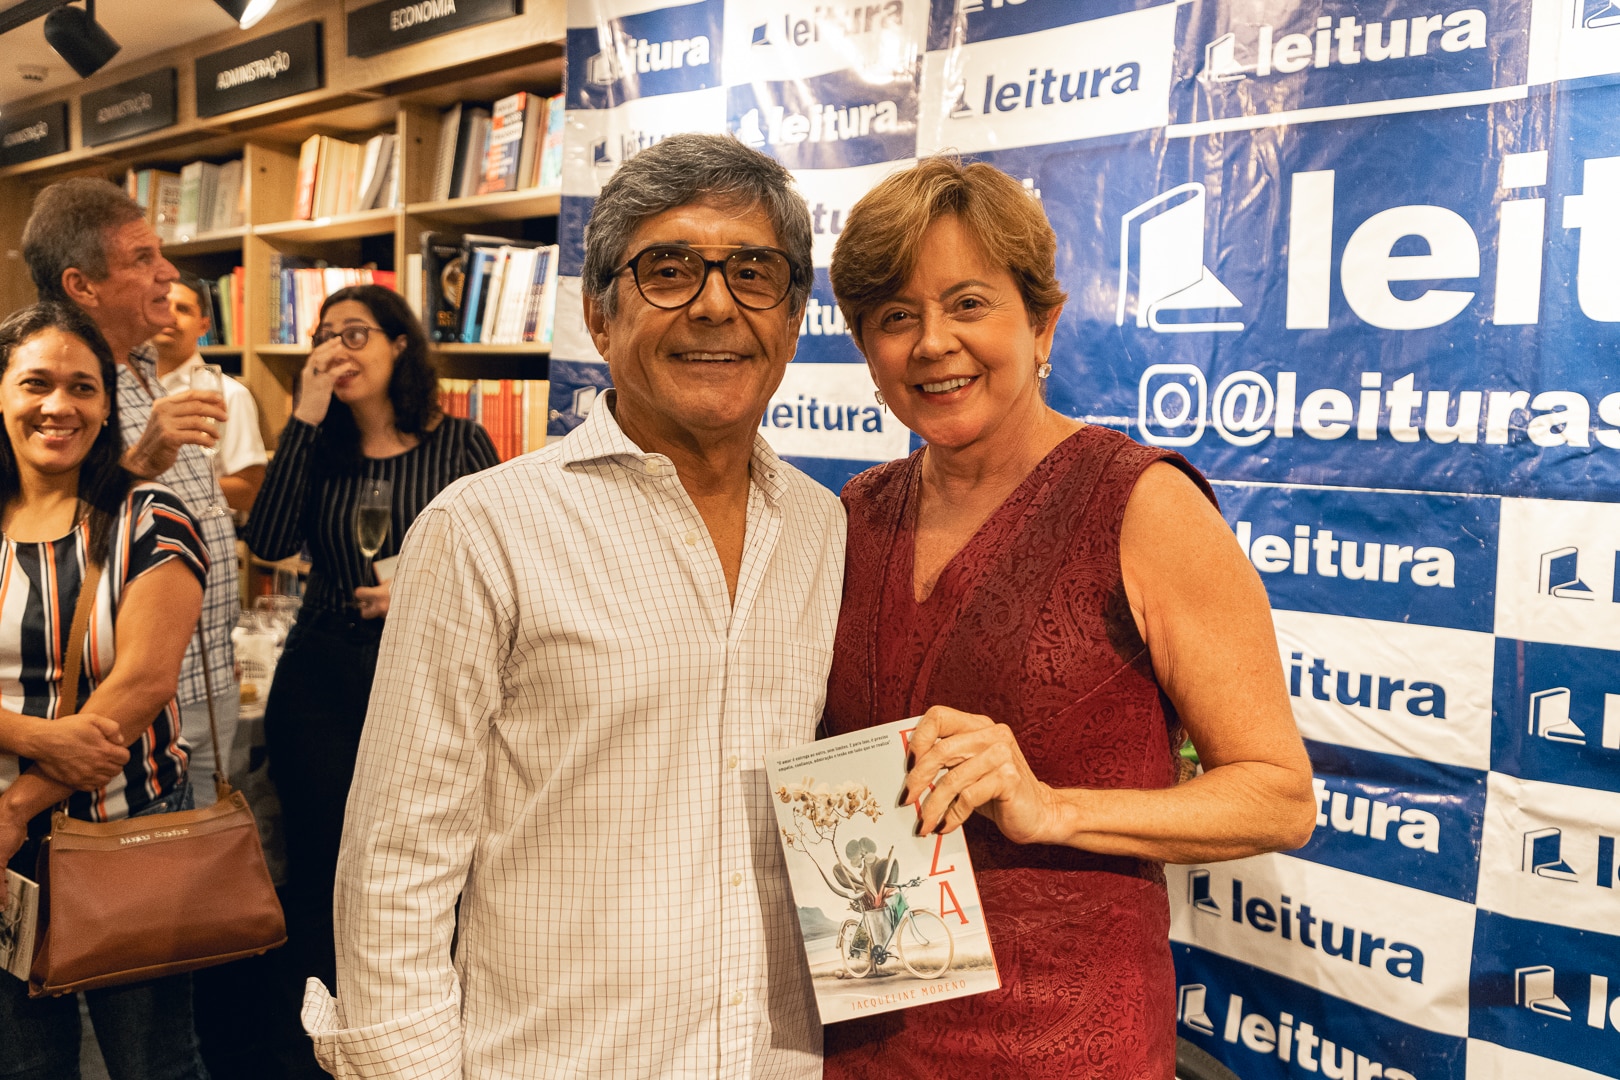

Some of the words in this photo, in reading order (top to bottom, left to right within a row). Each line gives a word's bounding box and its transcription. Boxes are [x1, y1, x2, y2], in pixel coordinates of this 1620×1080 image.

[390, 0, 456, 31] ECONOMIA
[1256, 9, 1487, 77] leitura
[216, 50, 290, 90] ADMINISTRAÇÃO
[983, 62, 1141, 114] leitura
[768, 100, 898, 145] leitura
[1236, 520, 1456, 588] leitura
[1290, 651, 1447, 720] itura
[1312, 777, 1440, 854] tura
[1232, 878, 1424, 984] leitura
[851, 989, 916, 1011] JACQUELINE
[921, 979, 966, 996] MORENO
